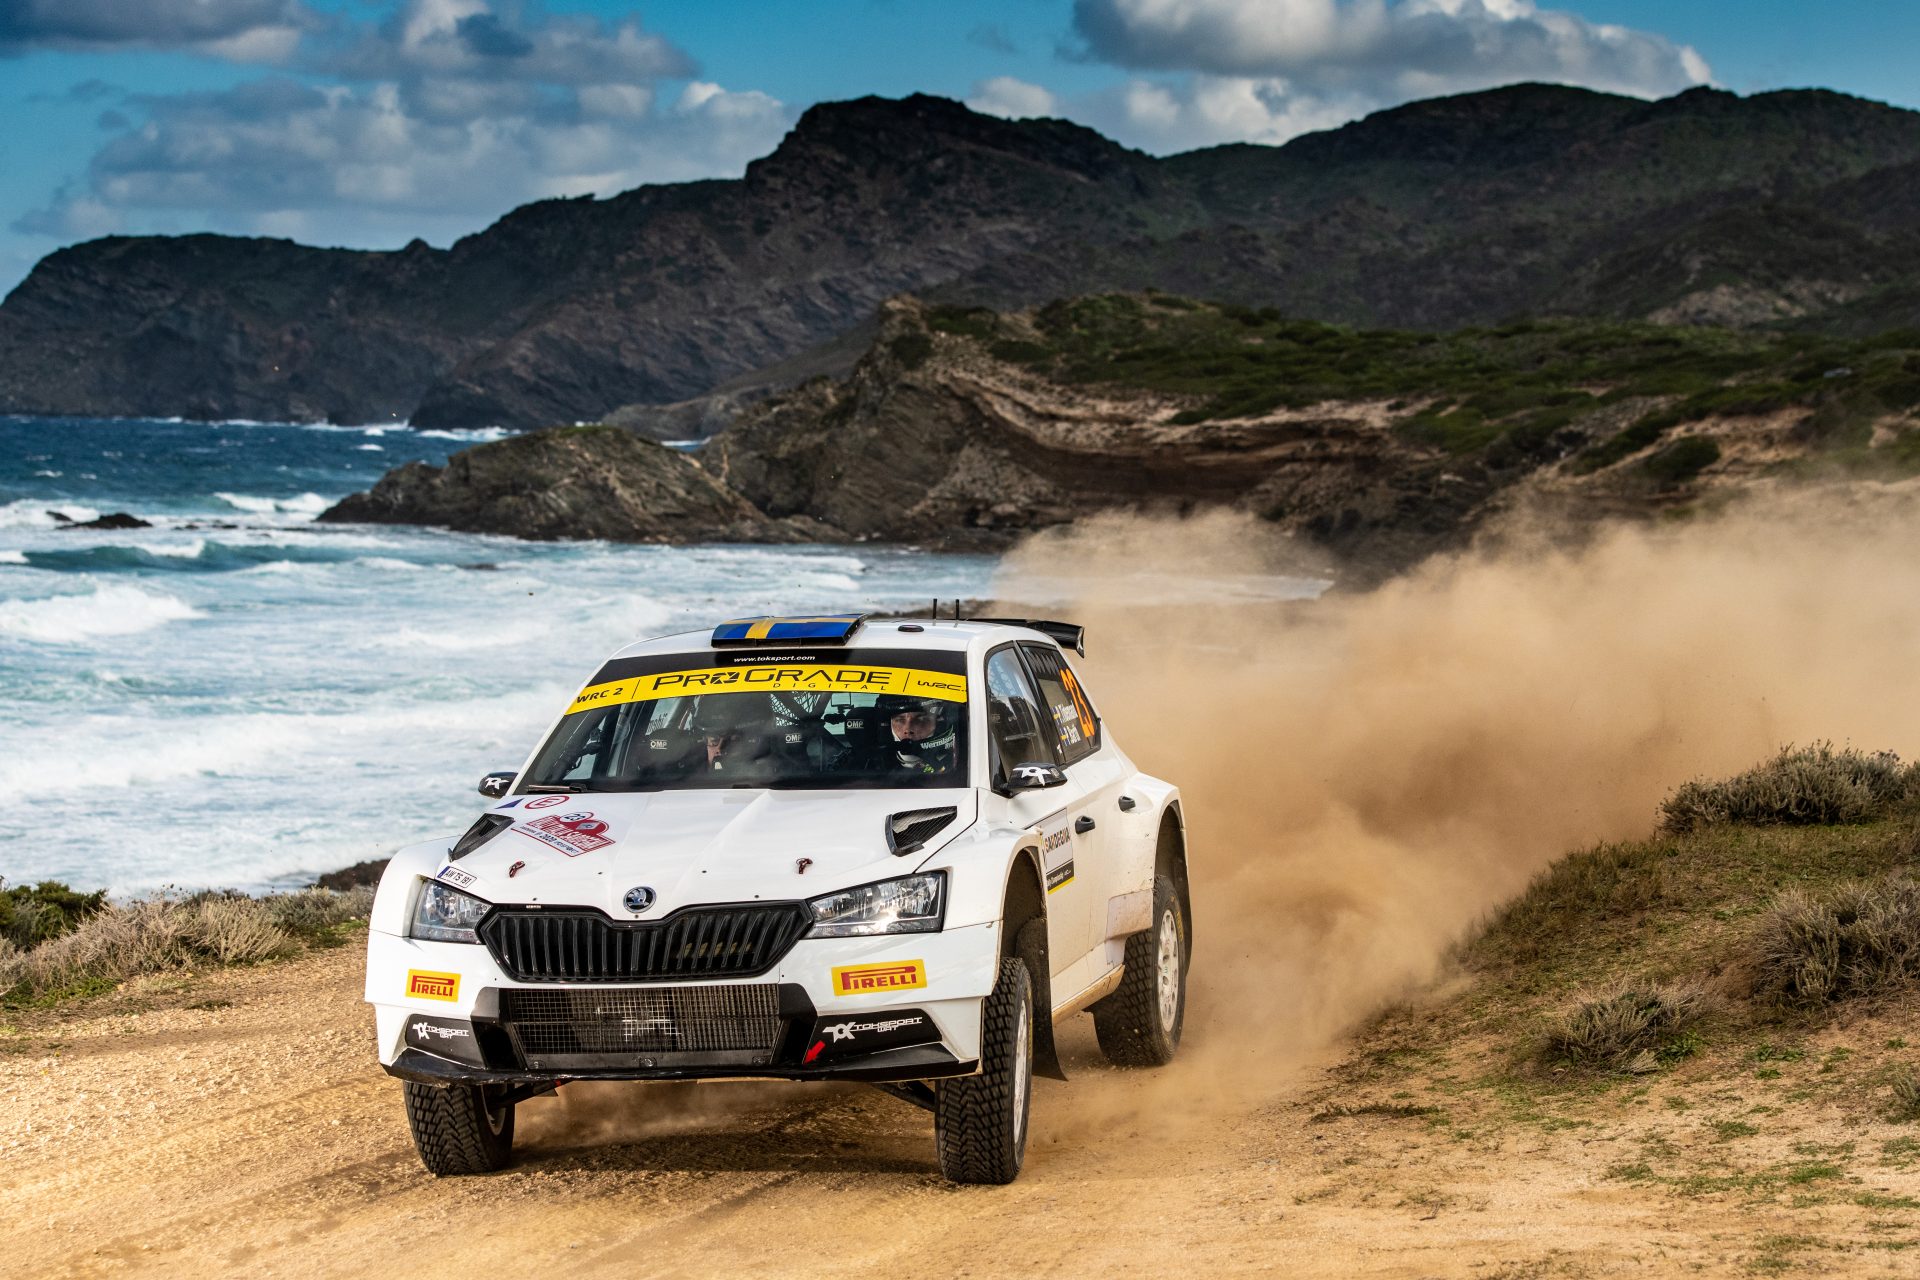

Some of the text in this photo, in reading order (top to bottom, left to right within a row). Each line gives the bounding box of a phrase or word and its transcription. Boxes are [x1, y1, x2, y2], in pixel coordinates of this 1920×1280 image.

[733, 654, 816, 663] www.toksport.com
[772, 683, 887, 691] DIGITAL
[576, 687, 624, 704] WRC 2
[846, 719, 864, 729] OMP
[650, 740, 668, 749] OMP
[841, 966, 917, 991] PIRELLI
[411, 975, 455, 997] PIRELLI
